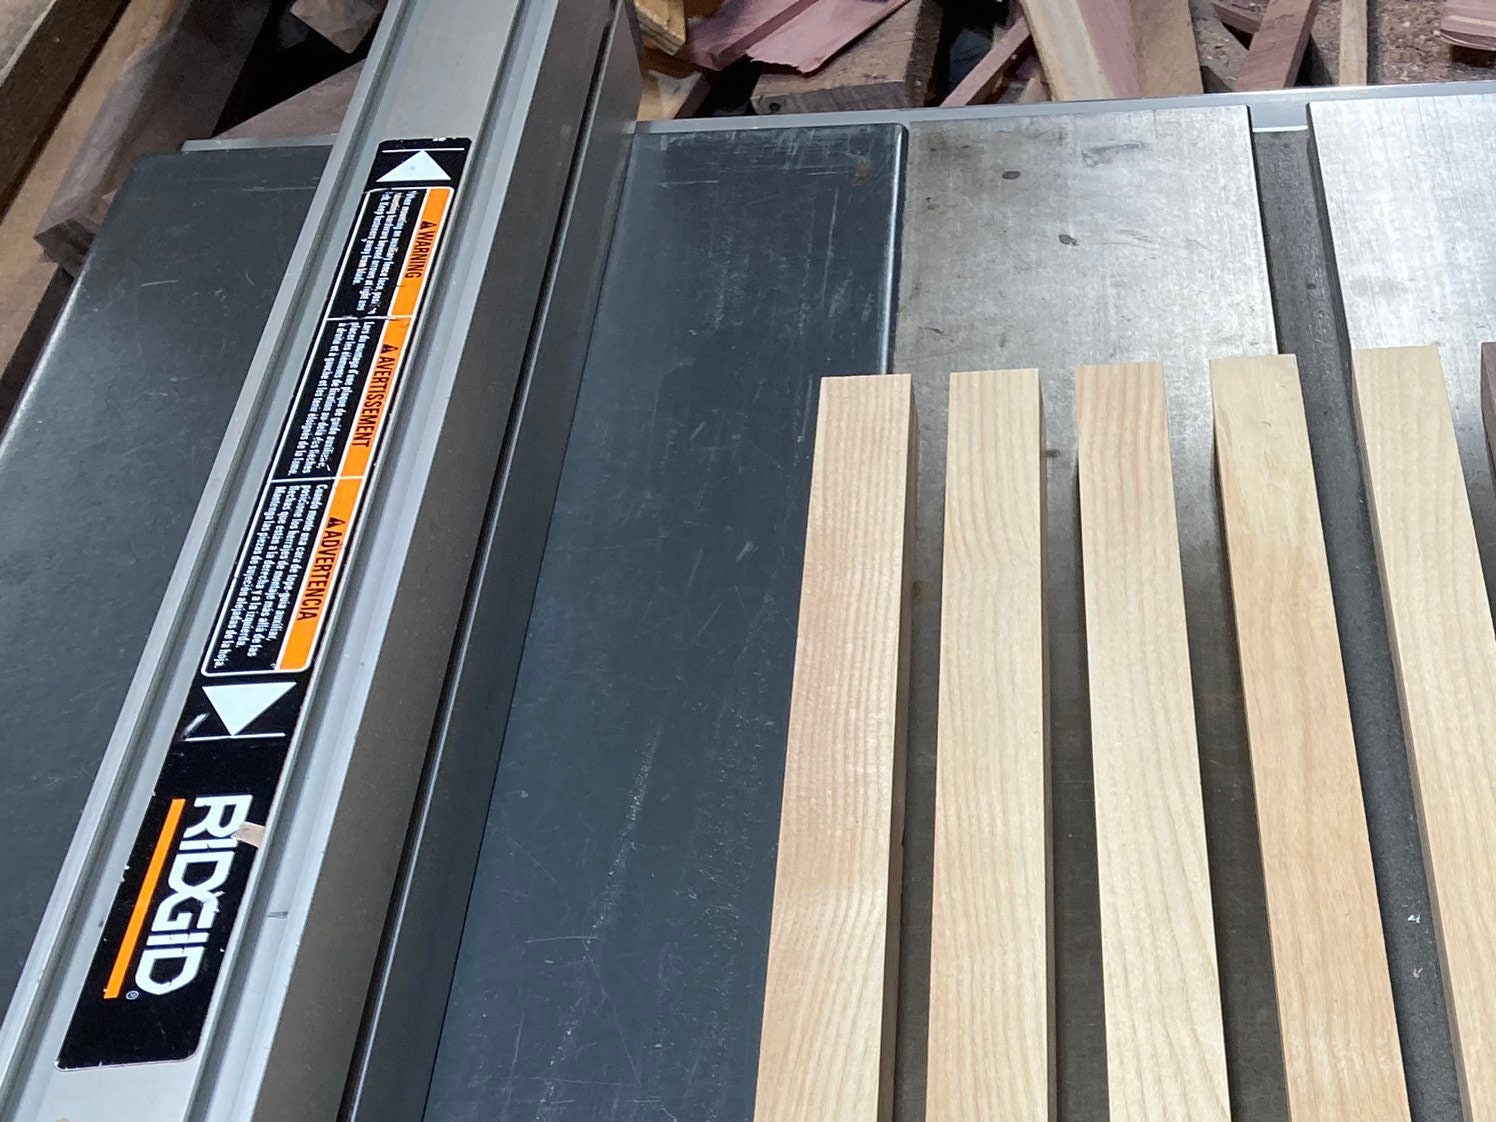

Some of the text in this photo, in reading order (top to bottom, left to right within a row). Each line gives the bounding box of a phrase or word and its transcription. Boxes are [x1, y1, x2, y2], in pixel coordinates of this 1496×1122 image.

[405, 231, 434, 278] WARNING
[353, 356, 392, 447] AVERTISSEMENT
[298, 533, 335, 620] ADVERTENCIA
[135, 795, 252, 995] RIDGID
